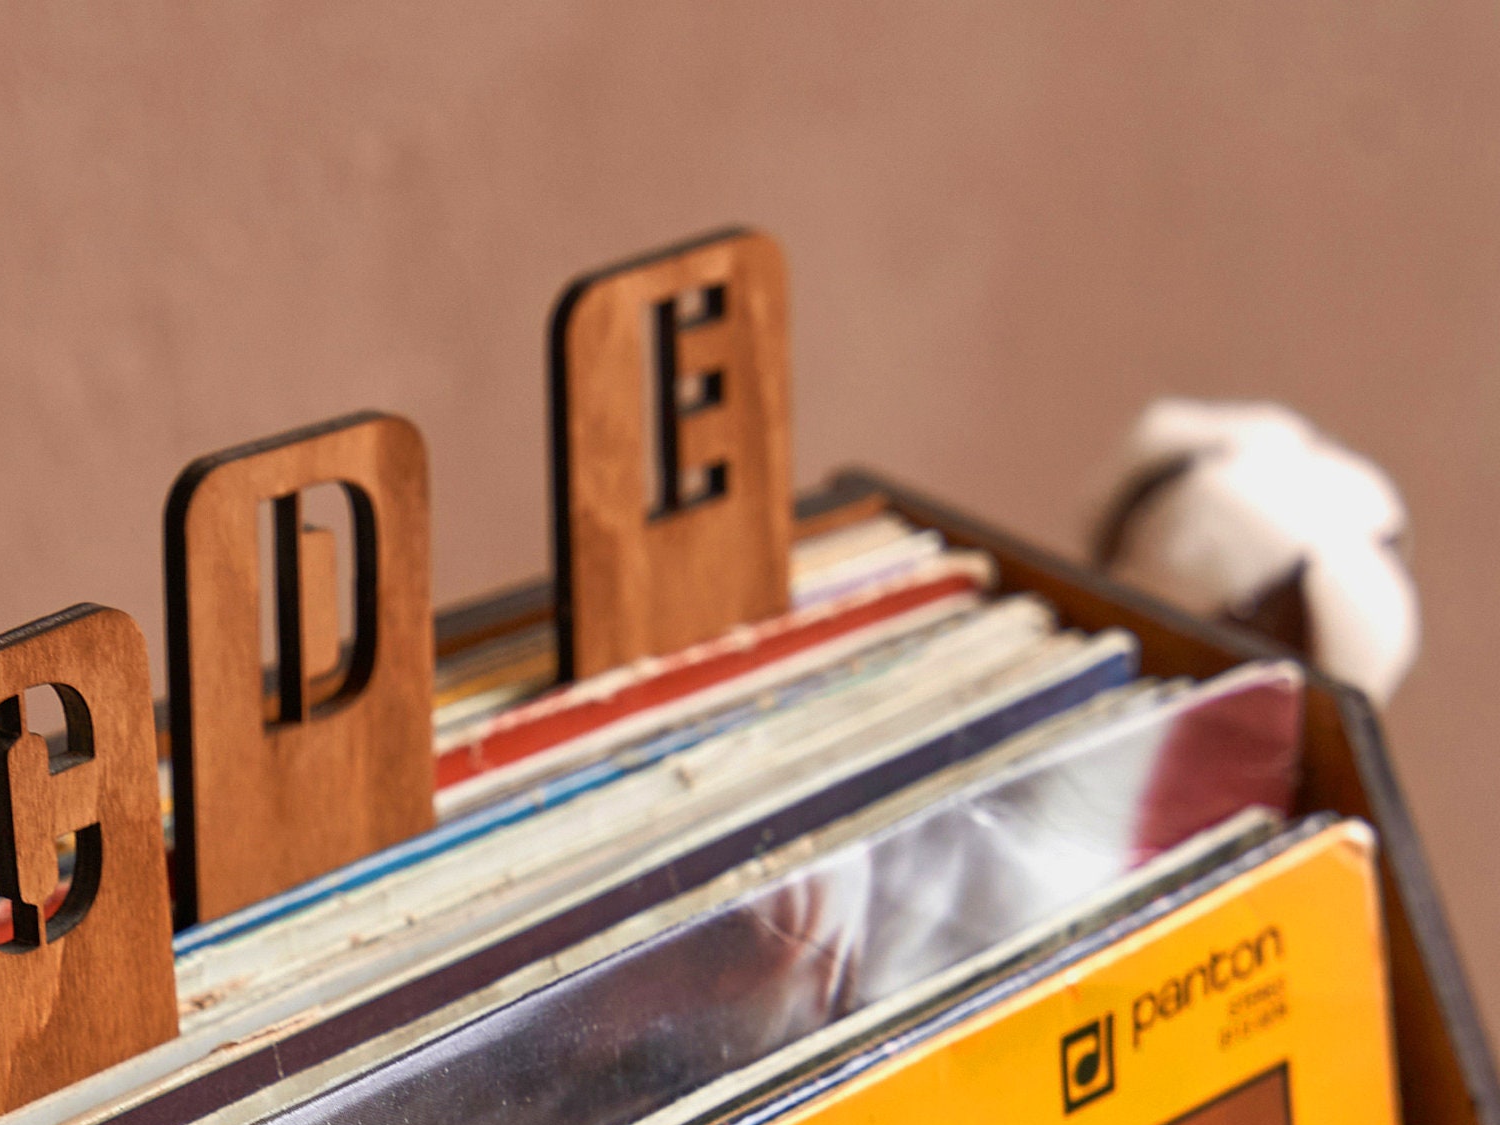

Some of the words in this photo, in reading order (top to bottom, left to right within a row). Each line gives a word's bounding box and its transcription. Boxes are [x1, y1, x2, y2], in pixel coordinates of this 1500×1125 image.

[640, 283, 730, 528] E
[256, 477, 378, 738] D
[1131, 924, 1285, 1051] panton
